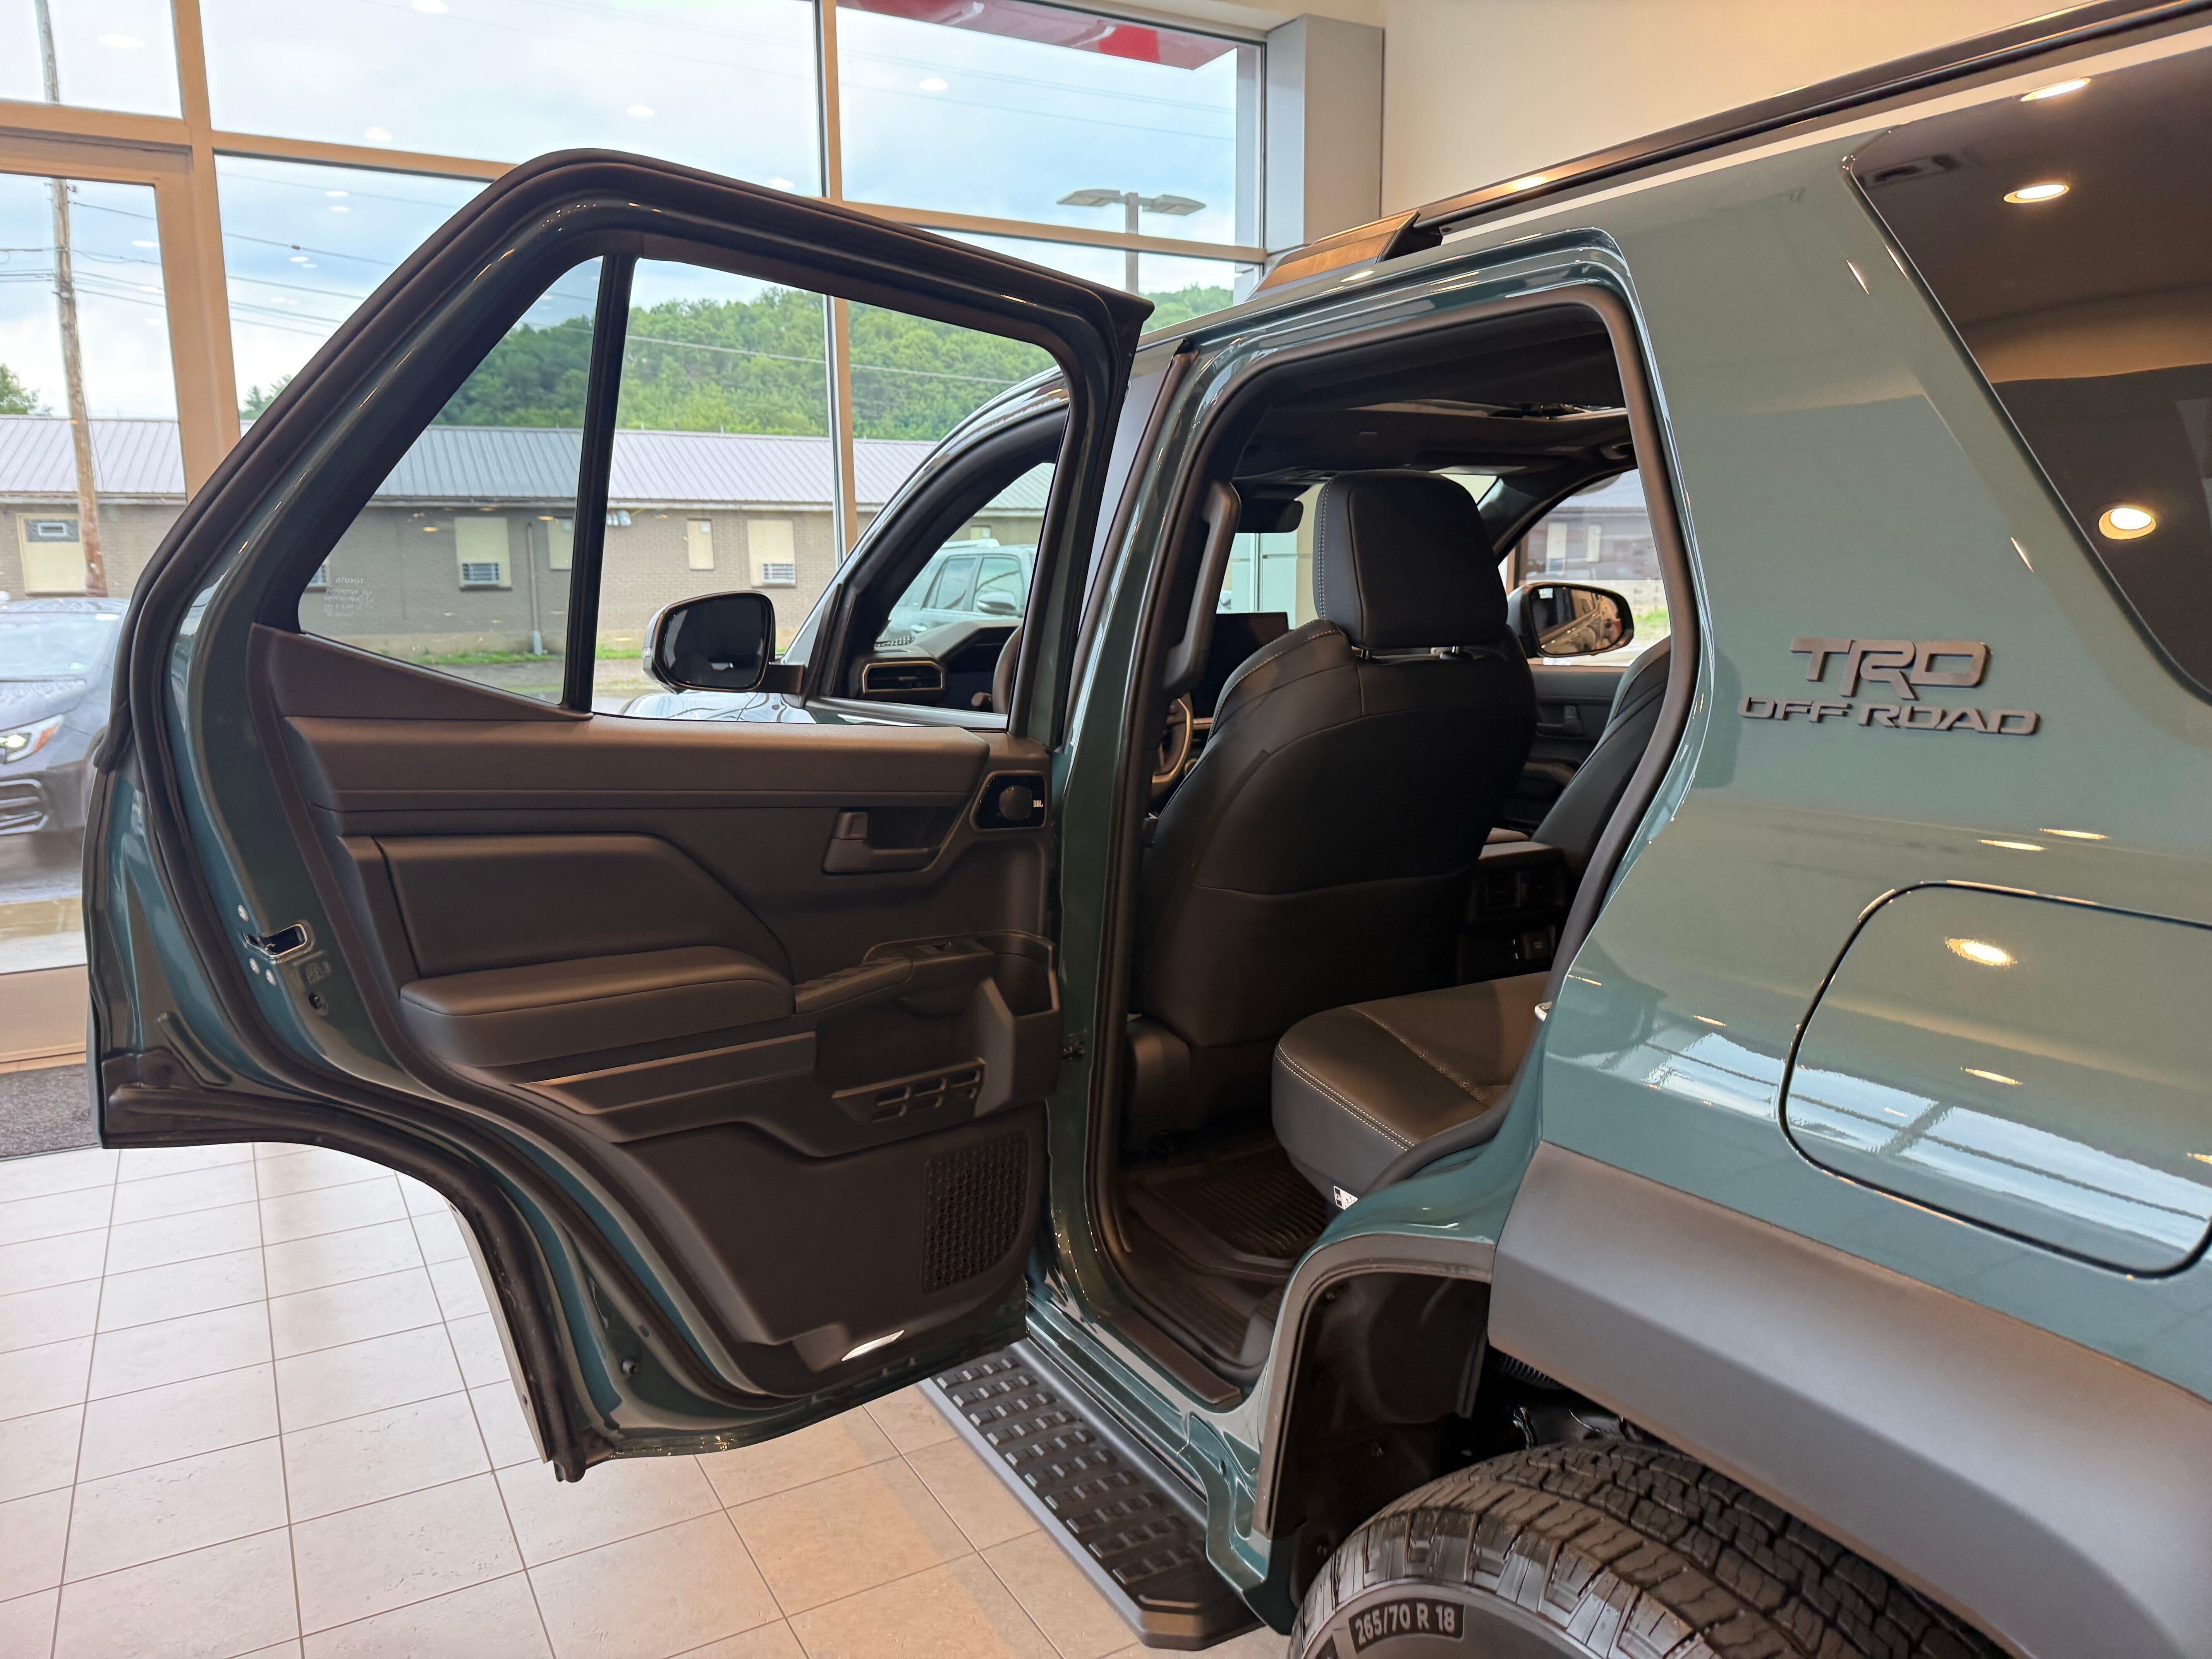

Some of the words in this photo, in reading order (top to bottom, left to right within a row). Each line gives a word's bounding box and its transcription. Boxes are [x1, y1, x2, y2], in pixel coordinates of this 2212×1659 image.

[1790, 637, 1990, 701] TRD
[1739, 697, 1852, 723] OFF
[1858, 705, 2040, 735] ROAD
[1355, 1603, 1411, 1646] 265/70
[1416, 1602, 1430, 1630] R
[1435, 1604, 1455, 1634] 18
